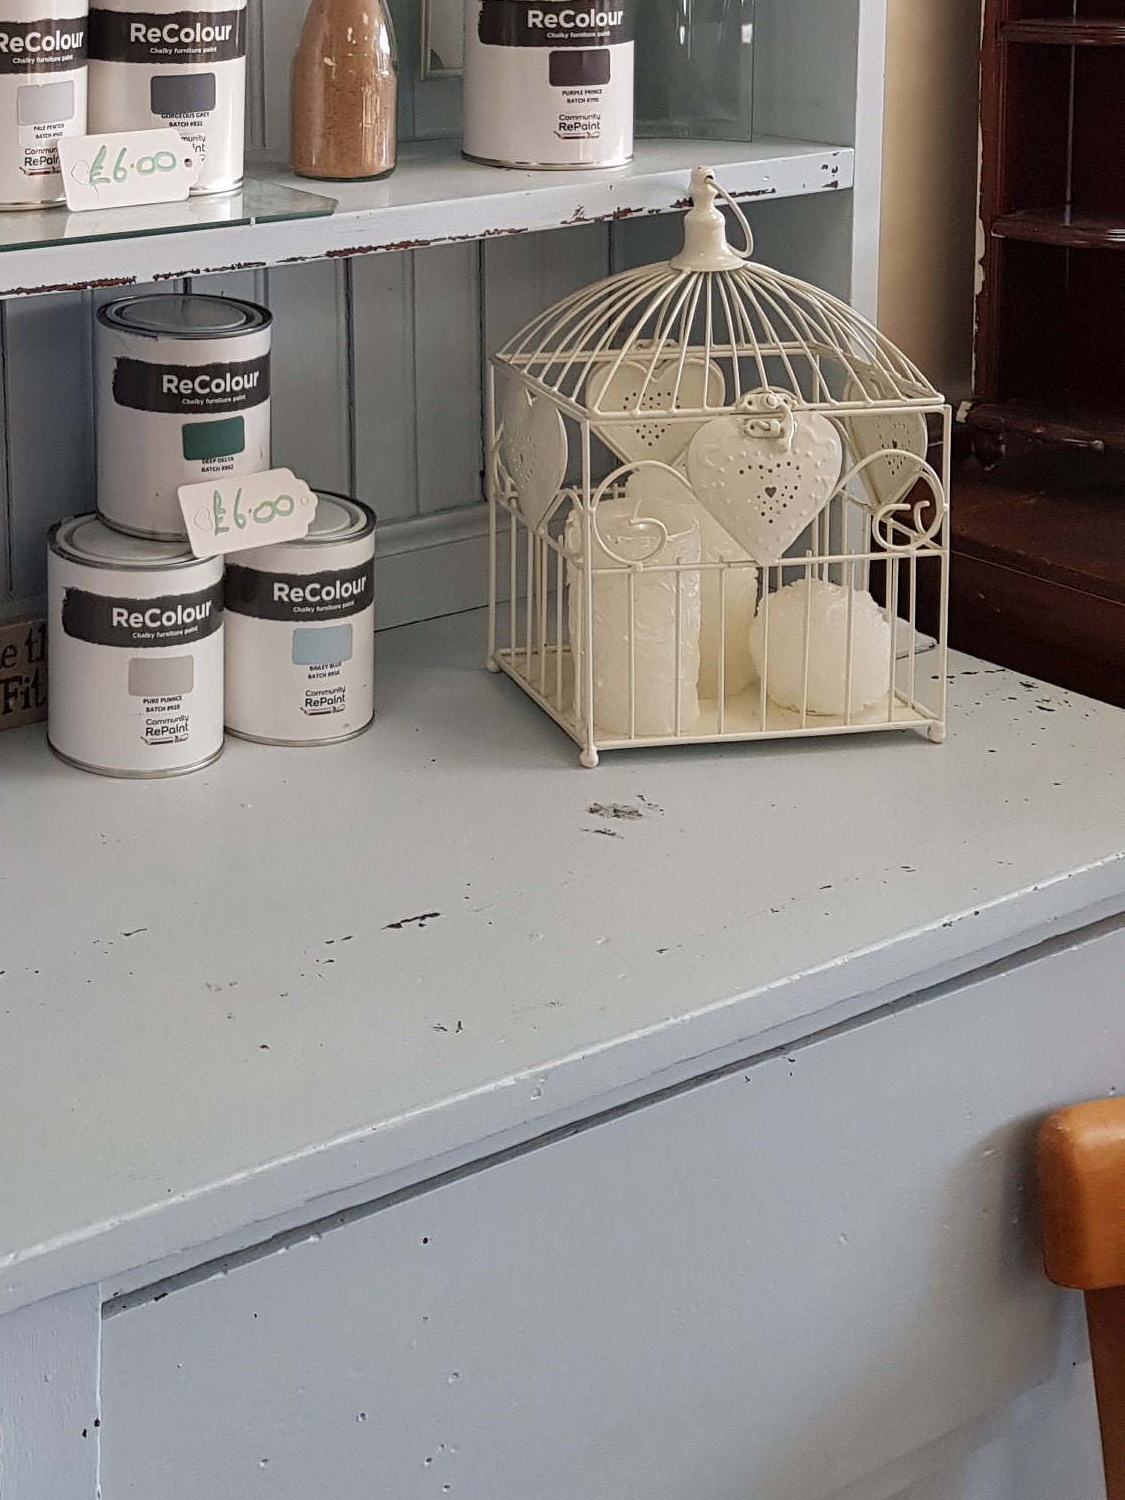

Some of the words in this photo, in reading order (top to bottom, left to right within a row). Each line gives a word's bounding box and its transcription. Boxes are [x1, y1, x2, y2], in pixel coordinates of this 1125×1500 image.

[528, 9, 624, 28] ReColour
[130, 23, 232, 43] ReColour
[559, 122, 600, 131] RePaint
[89, 145, 177, 186] £6.00
[163, 370, 260, 394] ReColour
[213, 487, 294, 537] £6.00
[274, 576, 367, 602] ReColour
[112, 600, 212, 628] ReColour
[316, 603, 341, 611] furniture
[132, 631, 155, 639] Chalky
[306, 686, 346, 697] Community
[305, 694, 345, 707] RePaint
[146, 715, 189, 726] Community
[146, 723, 189, 737] RePaint
